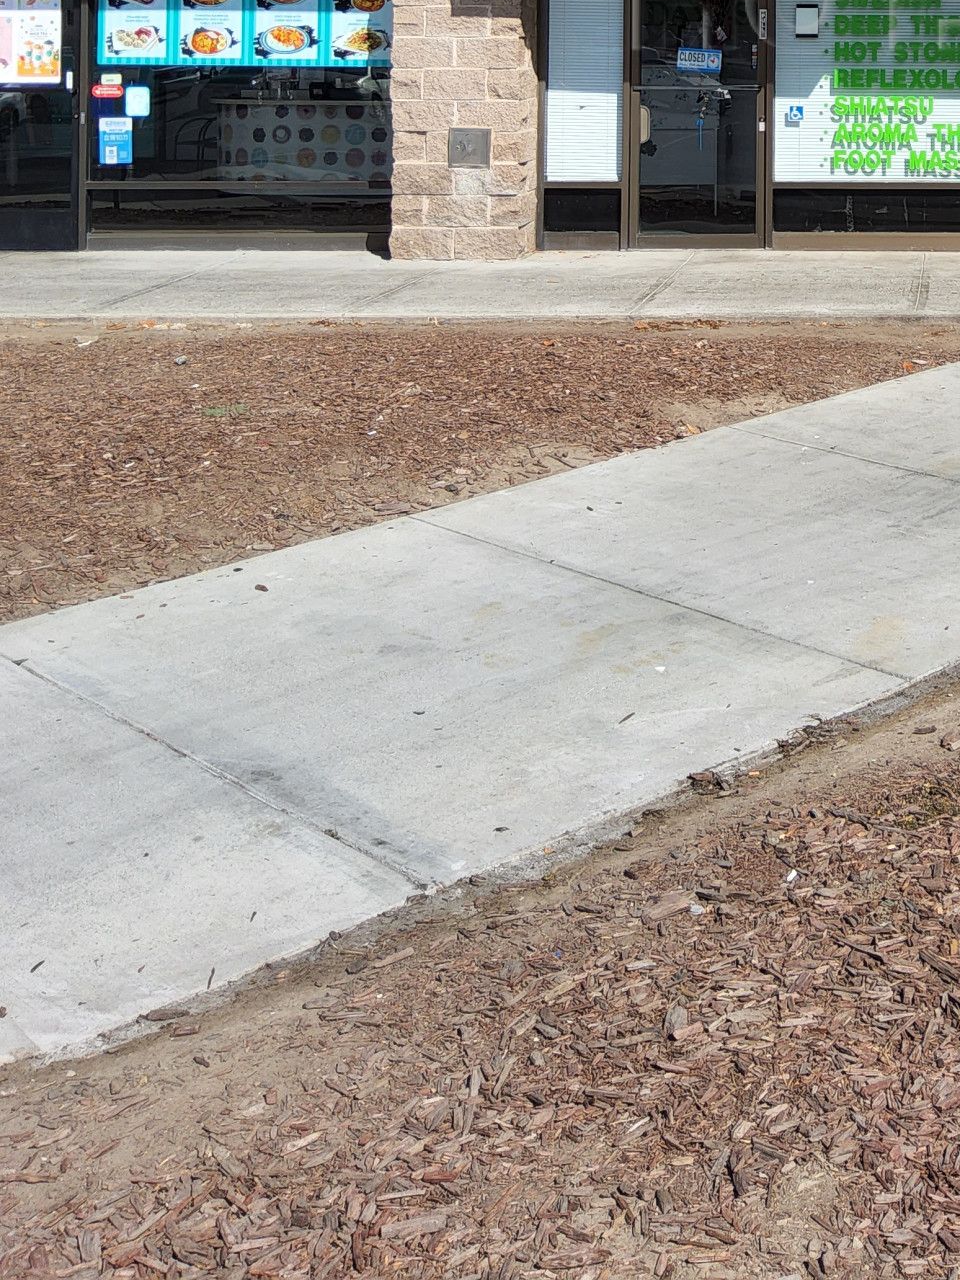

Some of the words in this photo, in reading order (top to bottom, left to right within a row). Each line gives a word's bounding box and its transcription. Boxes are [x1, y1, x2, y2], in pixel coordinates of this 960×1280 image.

[833, 14, 897, 36] DEEP
[679, 50, 707, 64] CLOSED
[833, 41, 882, 63] HOT
[833, 95, 934, 116] SHIATSU
[834, 123, 919, 143] AROMA
[833, 150, 896, 170] FOOT
